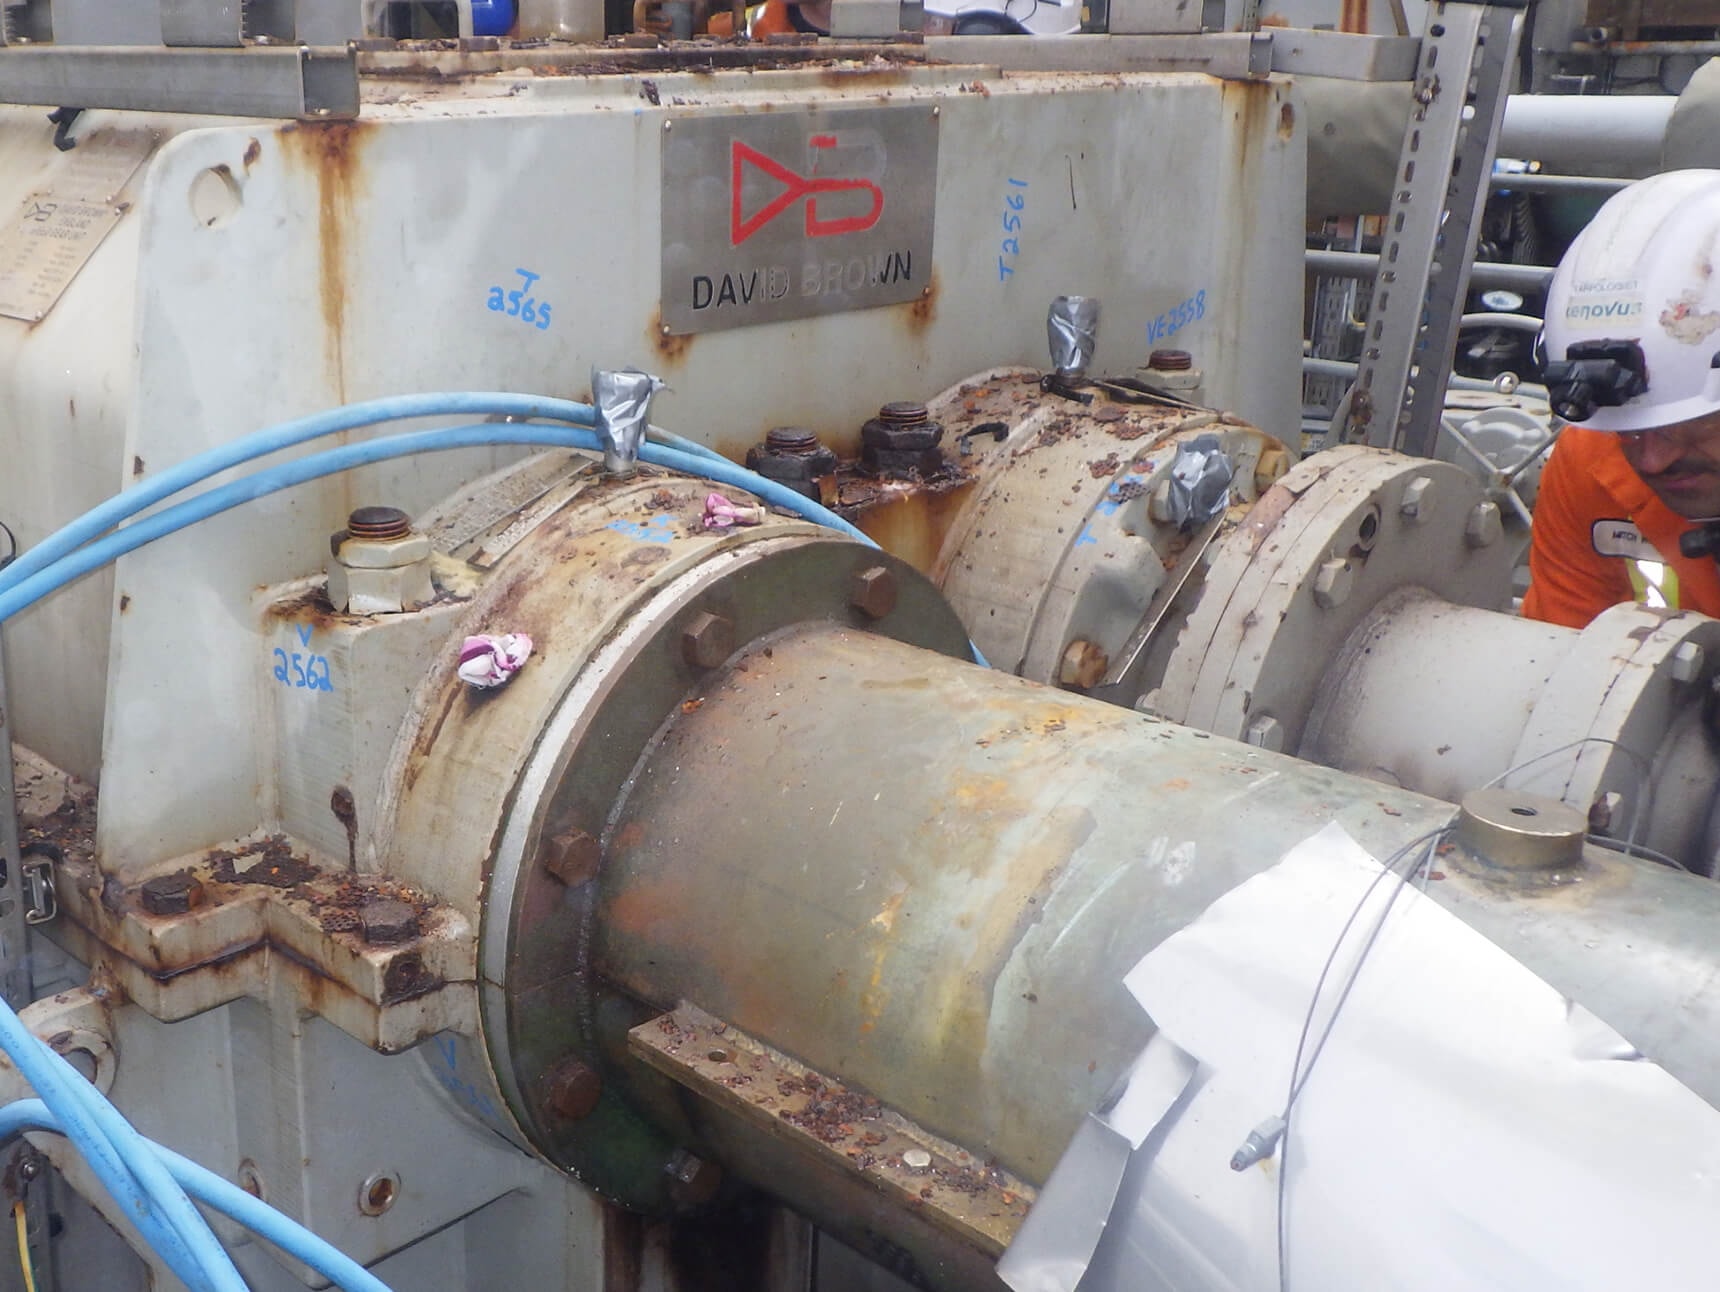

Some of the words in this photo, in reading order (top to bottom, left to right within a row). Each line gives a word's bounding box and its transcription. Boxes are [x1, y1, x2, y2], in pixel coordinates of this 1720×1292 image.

[515, 267, 540, 293] T
[692, 264, 791, 311] DAVID
[800, 250, 912, 298] BROWN
[296, 623, 314, 647] V
[273, 647, 334, 692] 2562
